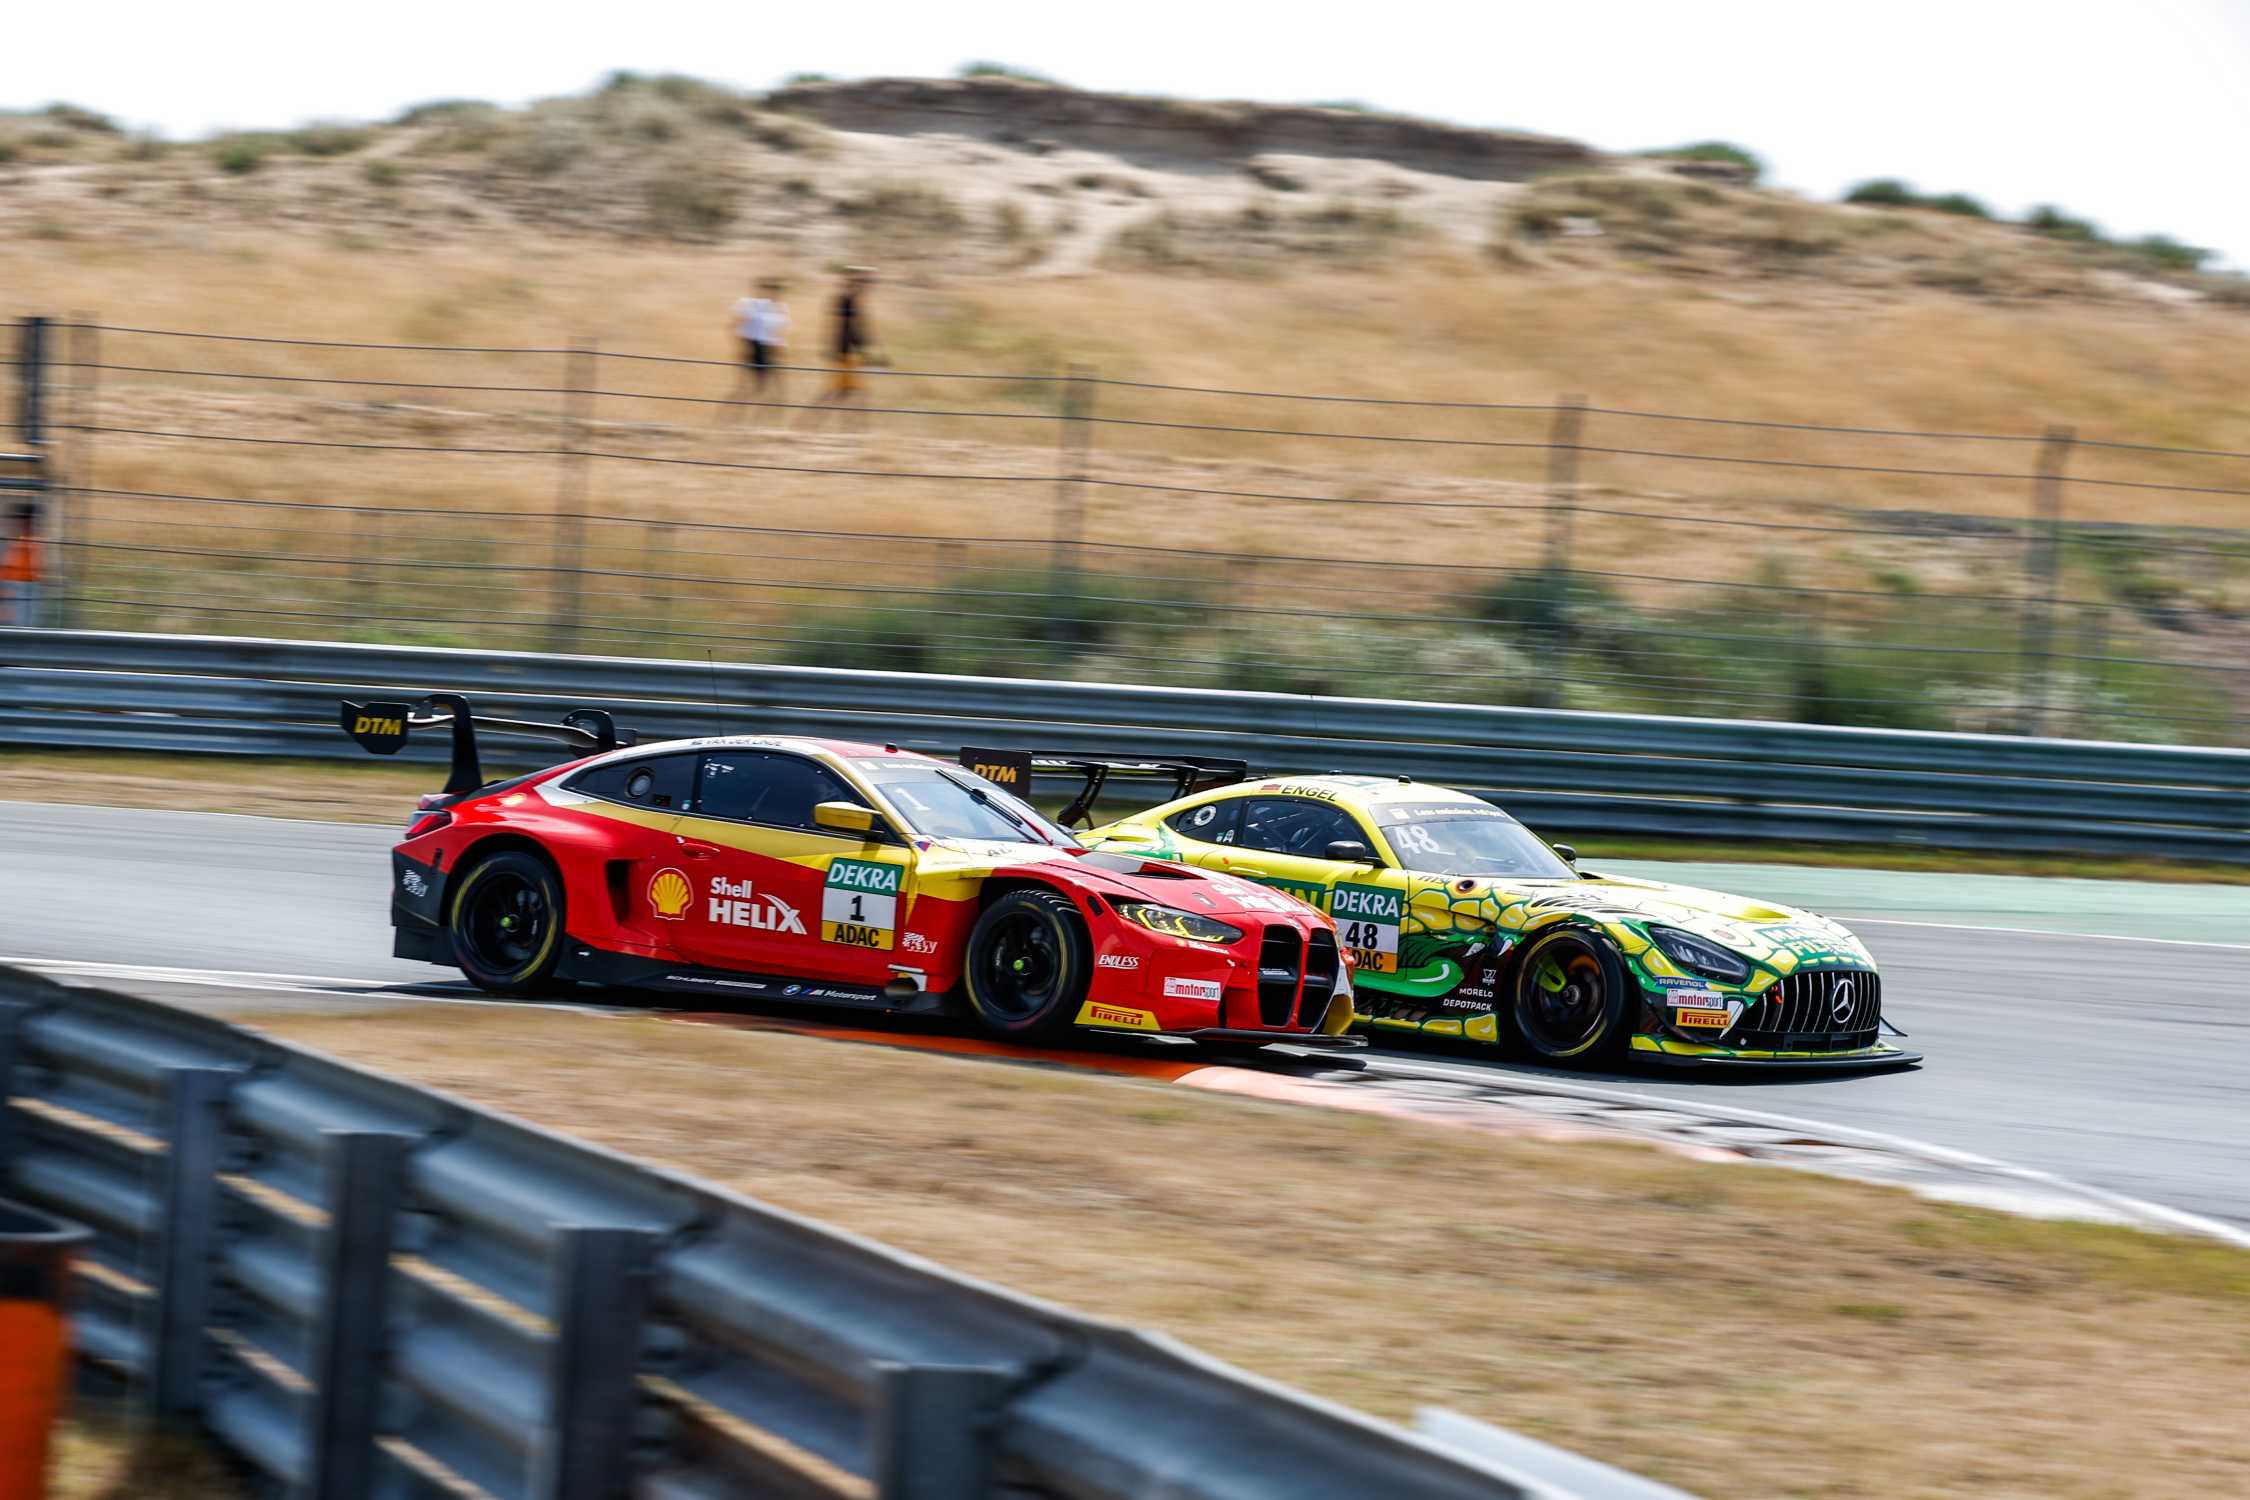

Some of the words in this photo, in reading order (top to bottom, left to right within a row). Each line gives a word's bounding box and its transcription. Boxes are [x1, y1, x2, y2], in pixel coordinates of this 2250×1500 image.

[352, 716, 402, 735] DTM
[1281, 785, 1337, 802] ENGEL
[1395, 825, 1441, 854] 48
[710, 876, 753, 899] Shell
[827, 863, 898, 892] DEKRA
[707, 893, 808, 935] HELIX
[850, 895, 865, 922] 1
[1333, 889, 1400, 918] DEKRA
[834, 923, 880, 947] ADAC
[1345, 922, 1379, 950] 48
[1098, 955, 1139, 970] ENDLESS
[1354, 950, 1384, 971] DAC
[824, 990, 877, 1001] Motorsport
[1459, 988, 1494, 998] MORELO
[1443, 998, 1493, 1011] DEPOTPACK
[1091, 1006, 1143, 1025] PIRELLI
[1681, 1012, 1729, 1026] PIRELLI
